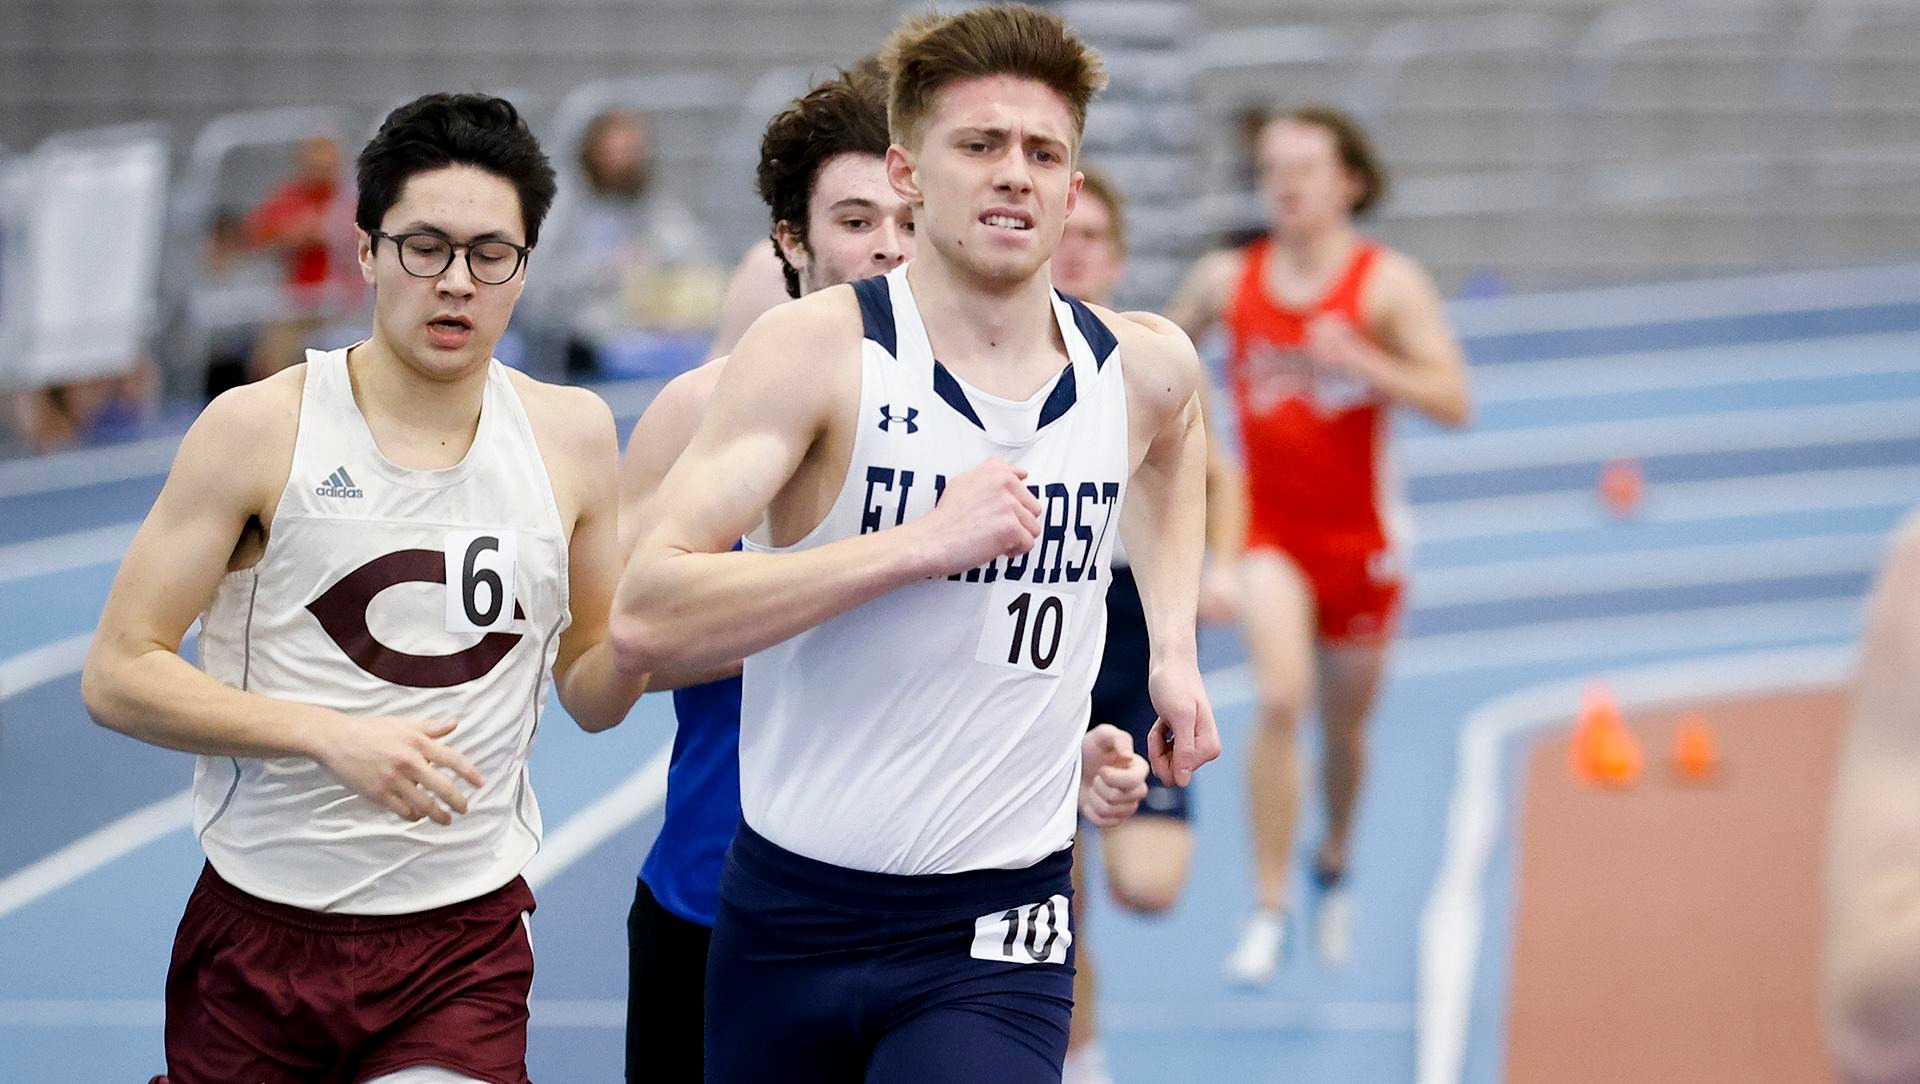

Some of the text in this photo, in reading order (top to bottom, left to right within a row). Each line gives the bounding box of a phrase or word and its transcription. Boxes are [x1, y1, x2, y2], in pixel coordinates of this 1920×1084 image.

[315, 486, 364, 499] adidas
[860, 466, 1119, 584] ERST
[305, 548, 526, 688] C
[462, 536, 503, 627] 6
[1007, 592, 1063, 670] 10
[1000, 899, 1059, 962] 10
